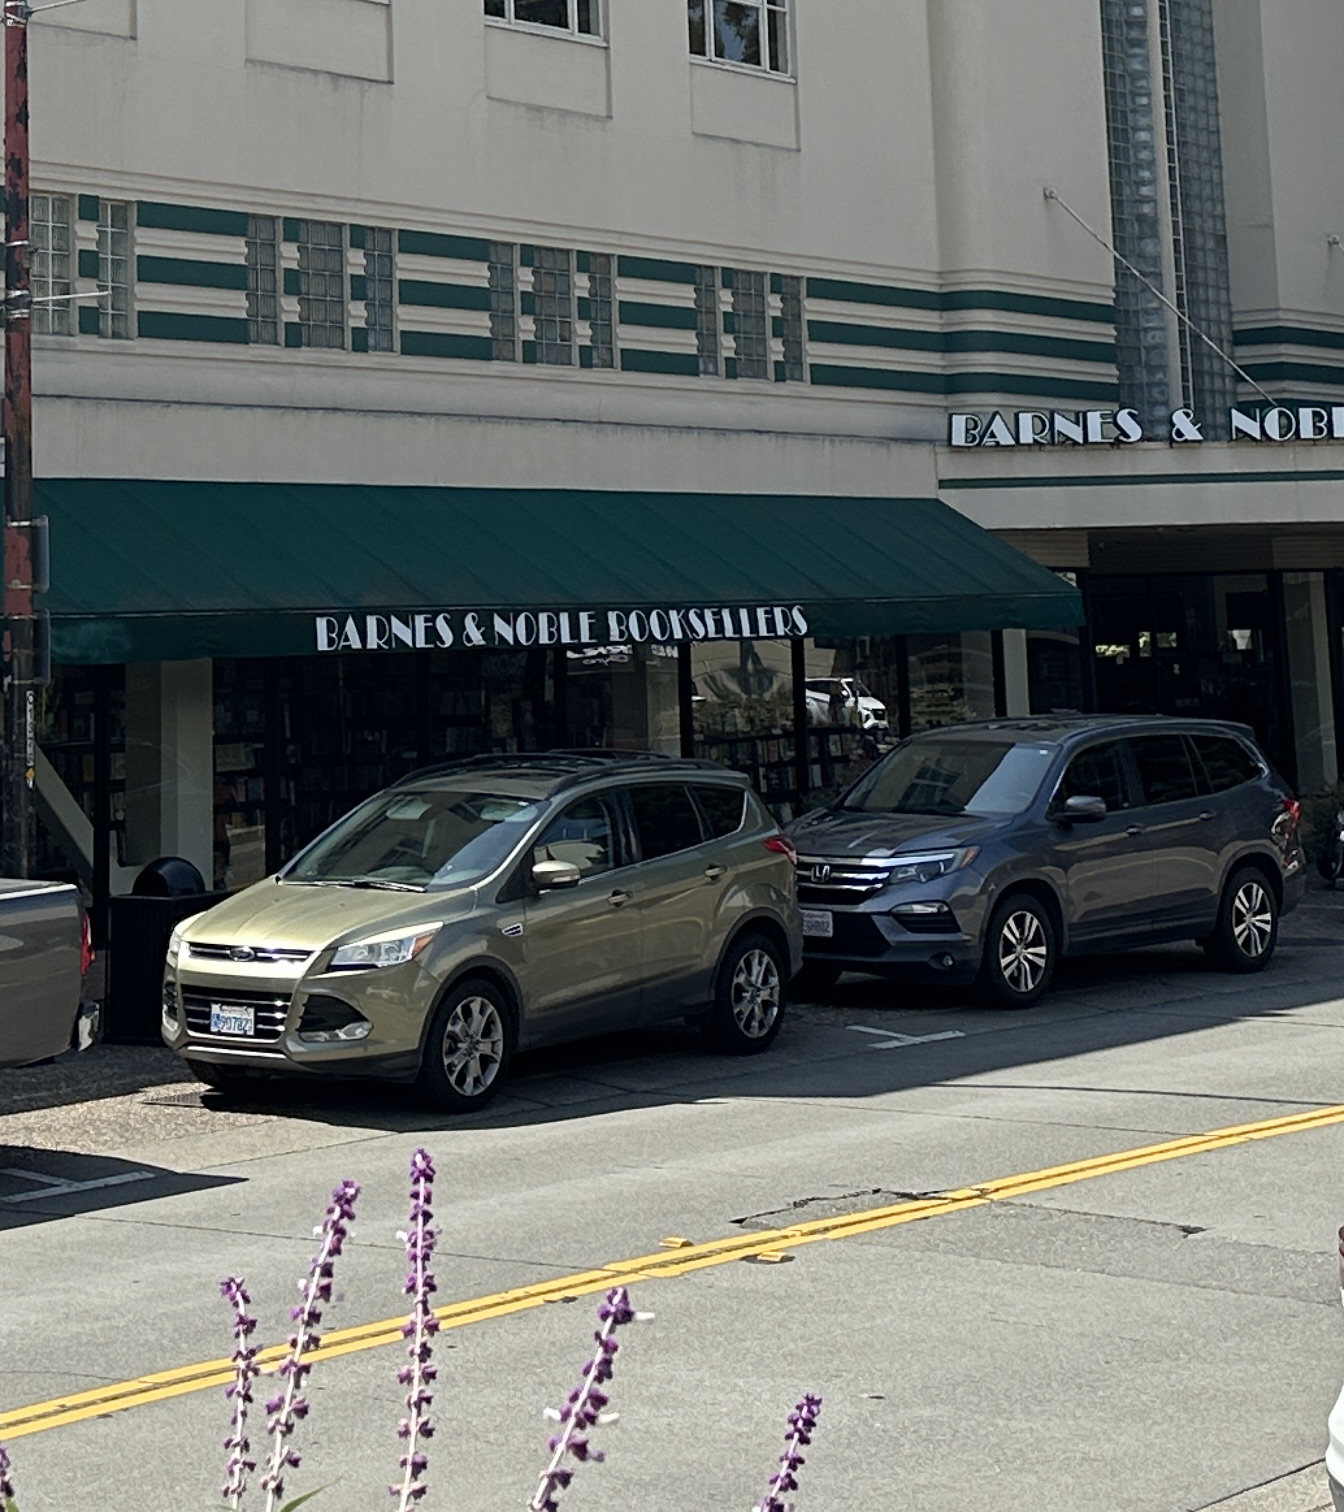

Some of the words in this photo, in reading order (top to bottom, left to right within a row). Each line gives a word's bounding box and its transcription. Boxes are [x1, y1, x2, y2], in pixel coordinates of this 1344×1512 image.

[952, 408, 1142, 447] BARNES
[1171, 408, 1204, 442] &
[315, 613, 455, 651] BARNES
[462, 612, 486, 647] &
[493, 611, 597, 646] NOBLE
[607, 605, 808, 643] BOOKSELLERS
